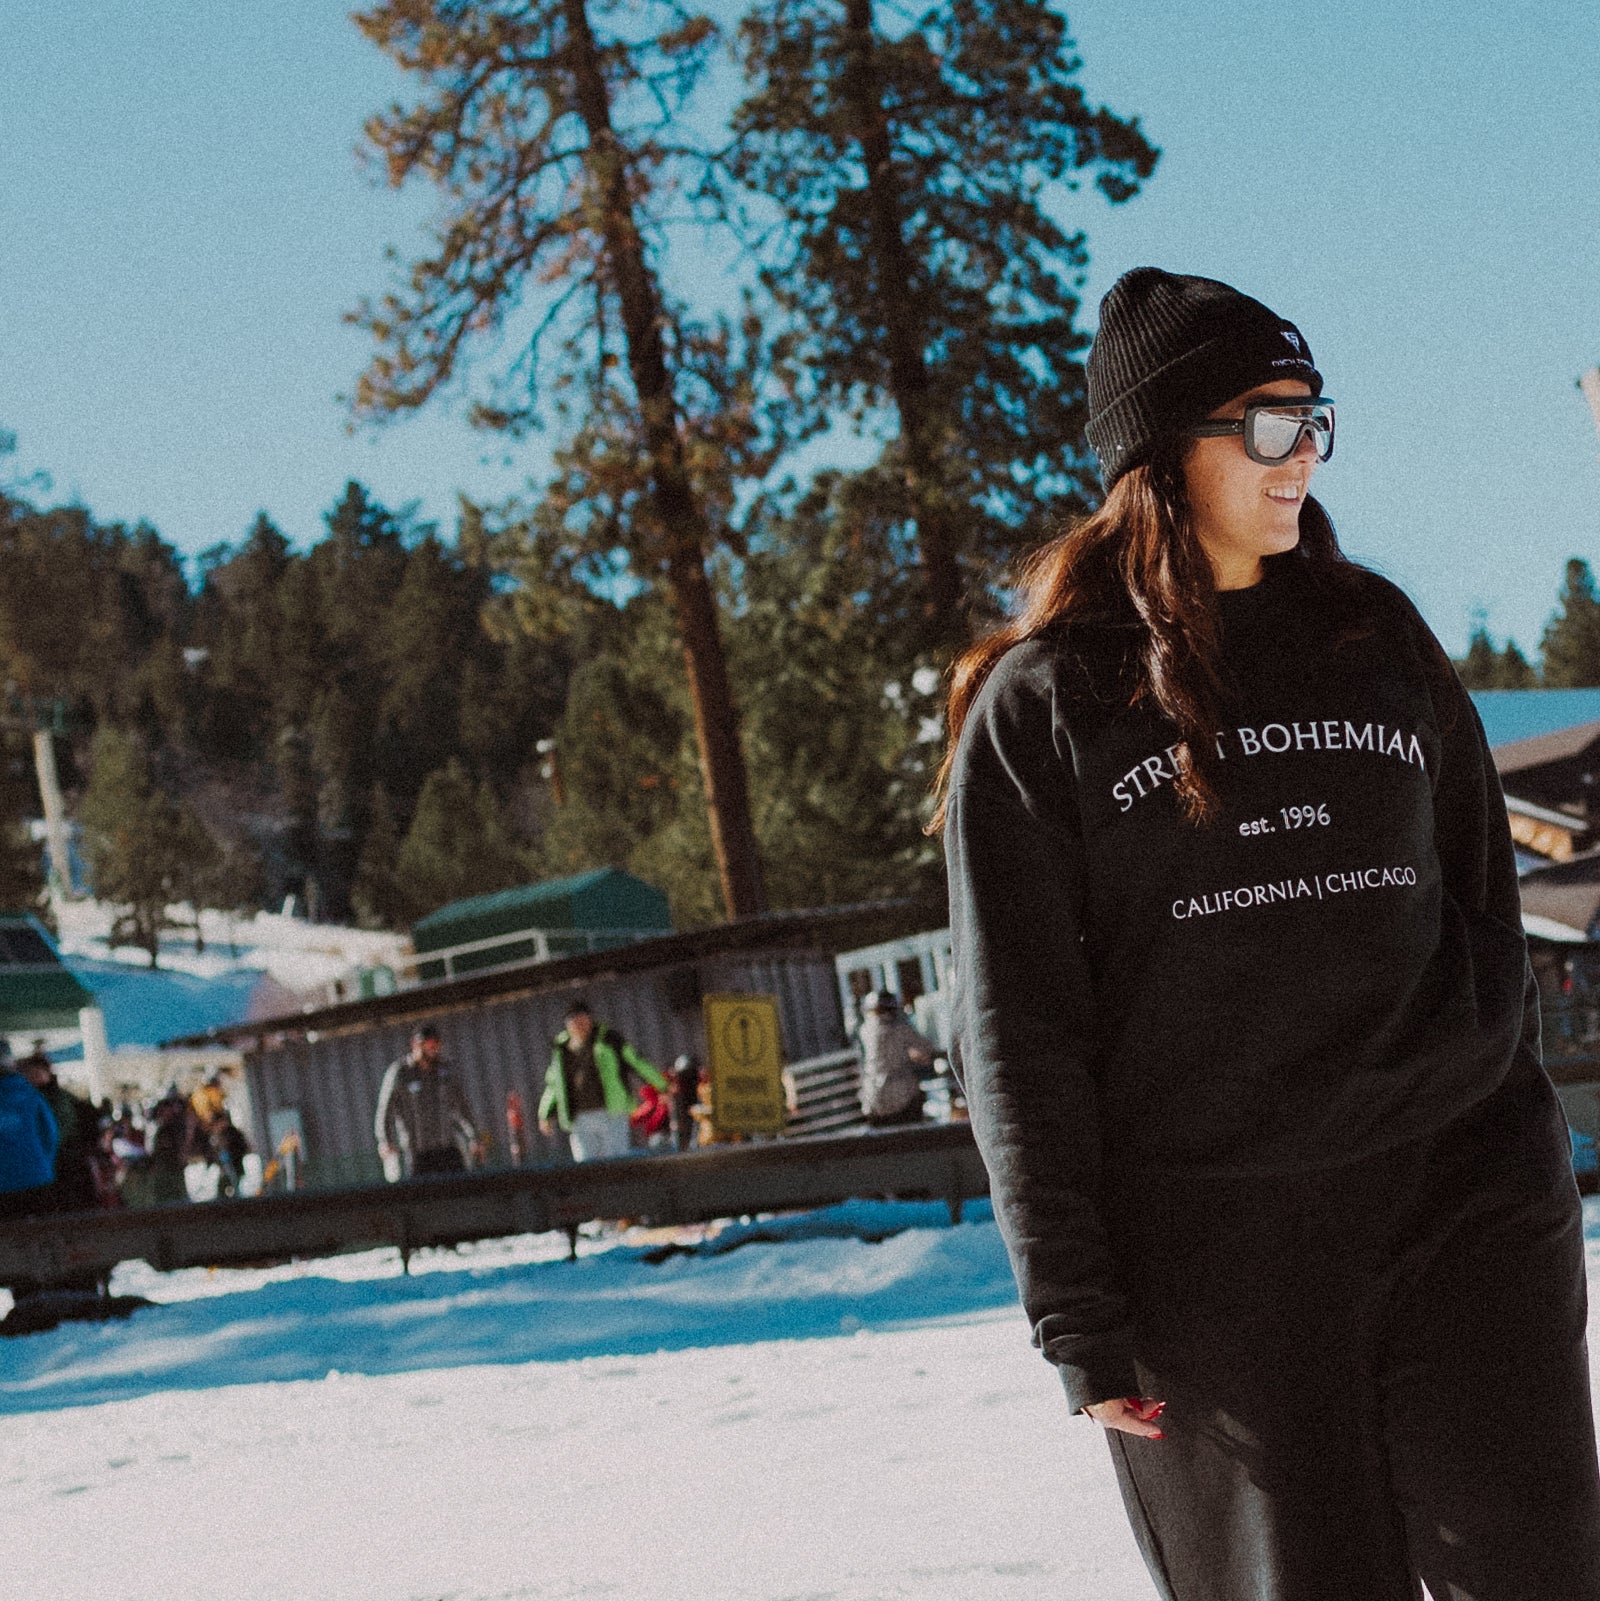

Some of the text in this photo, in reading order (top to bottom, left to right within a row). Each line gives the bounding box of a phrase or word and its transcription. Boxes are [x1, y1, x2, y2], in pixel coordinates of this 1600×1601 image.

[1112, 721, 1425, 812] STRET BOHEMIAN
[1239, 803, 1331, 836] est. 1996
